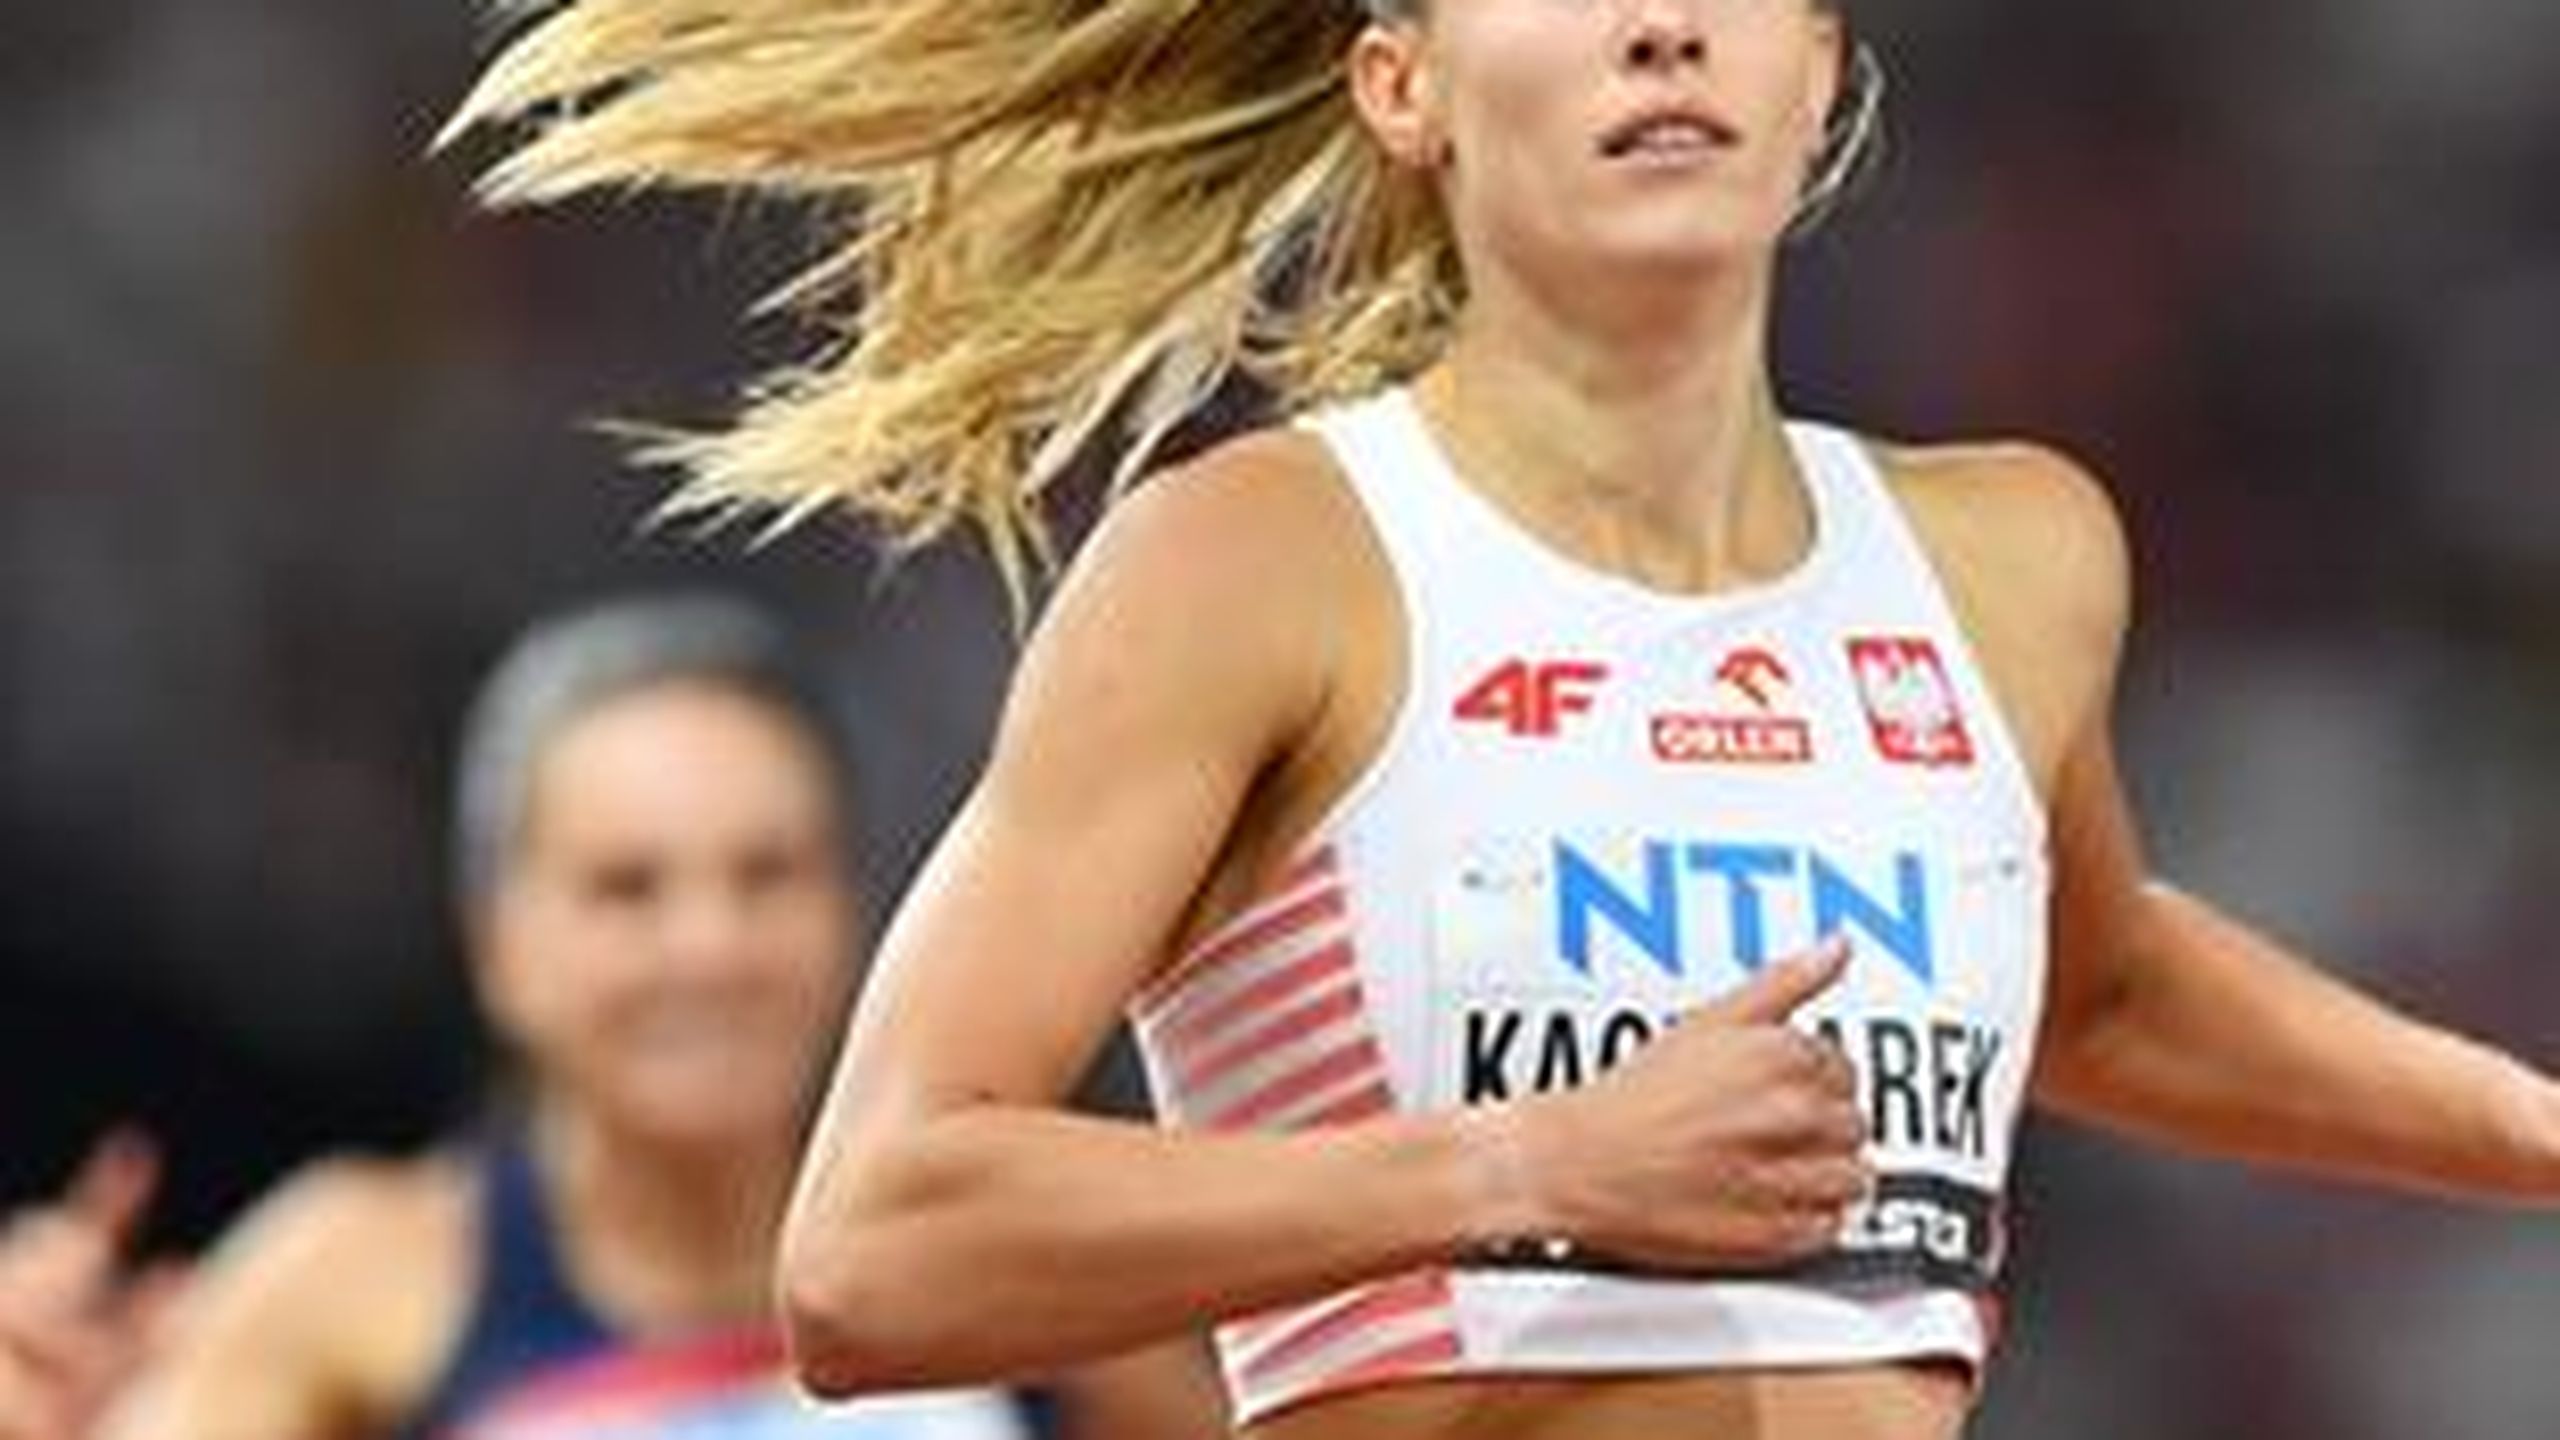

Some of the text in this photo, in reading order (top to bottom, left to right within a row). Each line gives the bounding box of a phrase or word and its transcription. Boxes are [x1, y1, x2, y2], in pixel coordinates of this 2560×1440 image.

[1453, 658, 1609, 735] 4F
[1658, 723, 1801, 757] ORLEN
[1551, 835, 1934, 986] NTN
